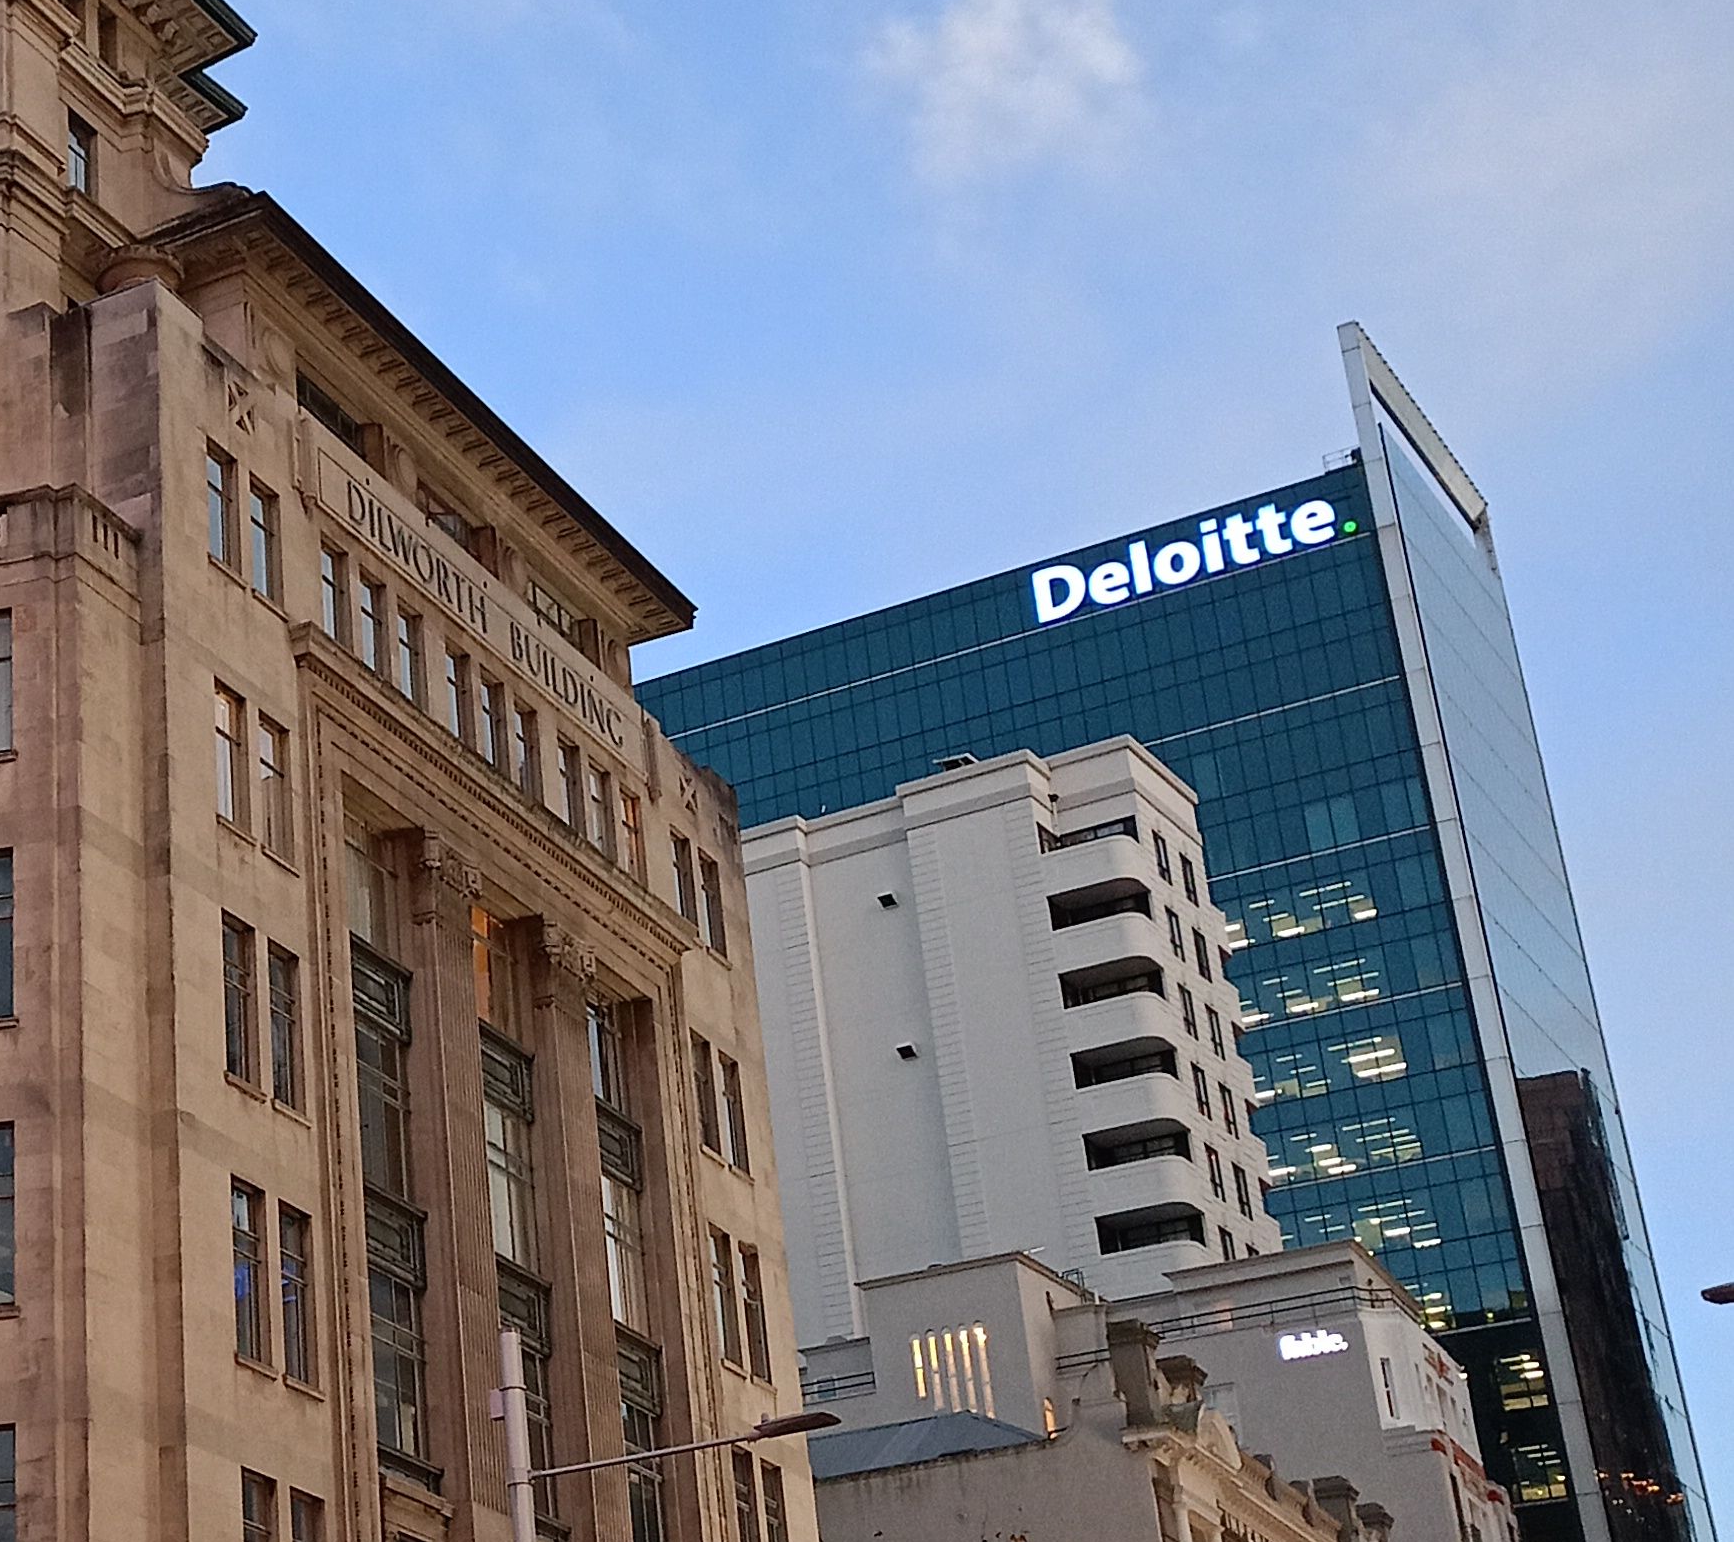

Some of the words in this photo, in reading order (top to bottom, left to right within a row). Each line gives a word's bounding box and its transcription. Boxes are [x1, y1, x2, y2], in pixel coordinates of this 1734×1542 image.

[346, 479, 487, 634] DILWORTH
[510, 621, 623, 749] BUILDING
[1031, 499, 1358, 624] Deloitte.
